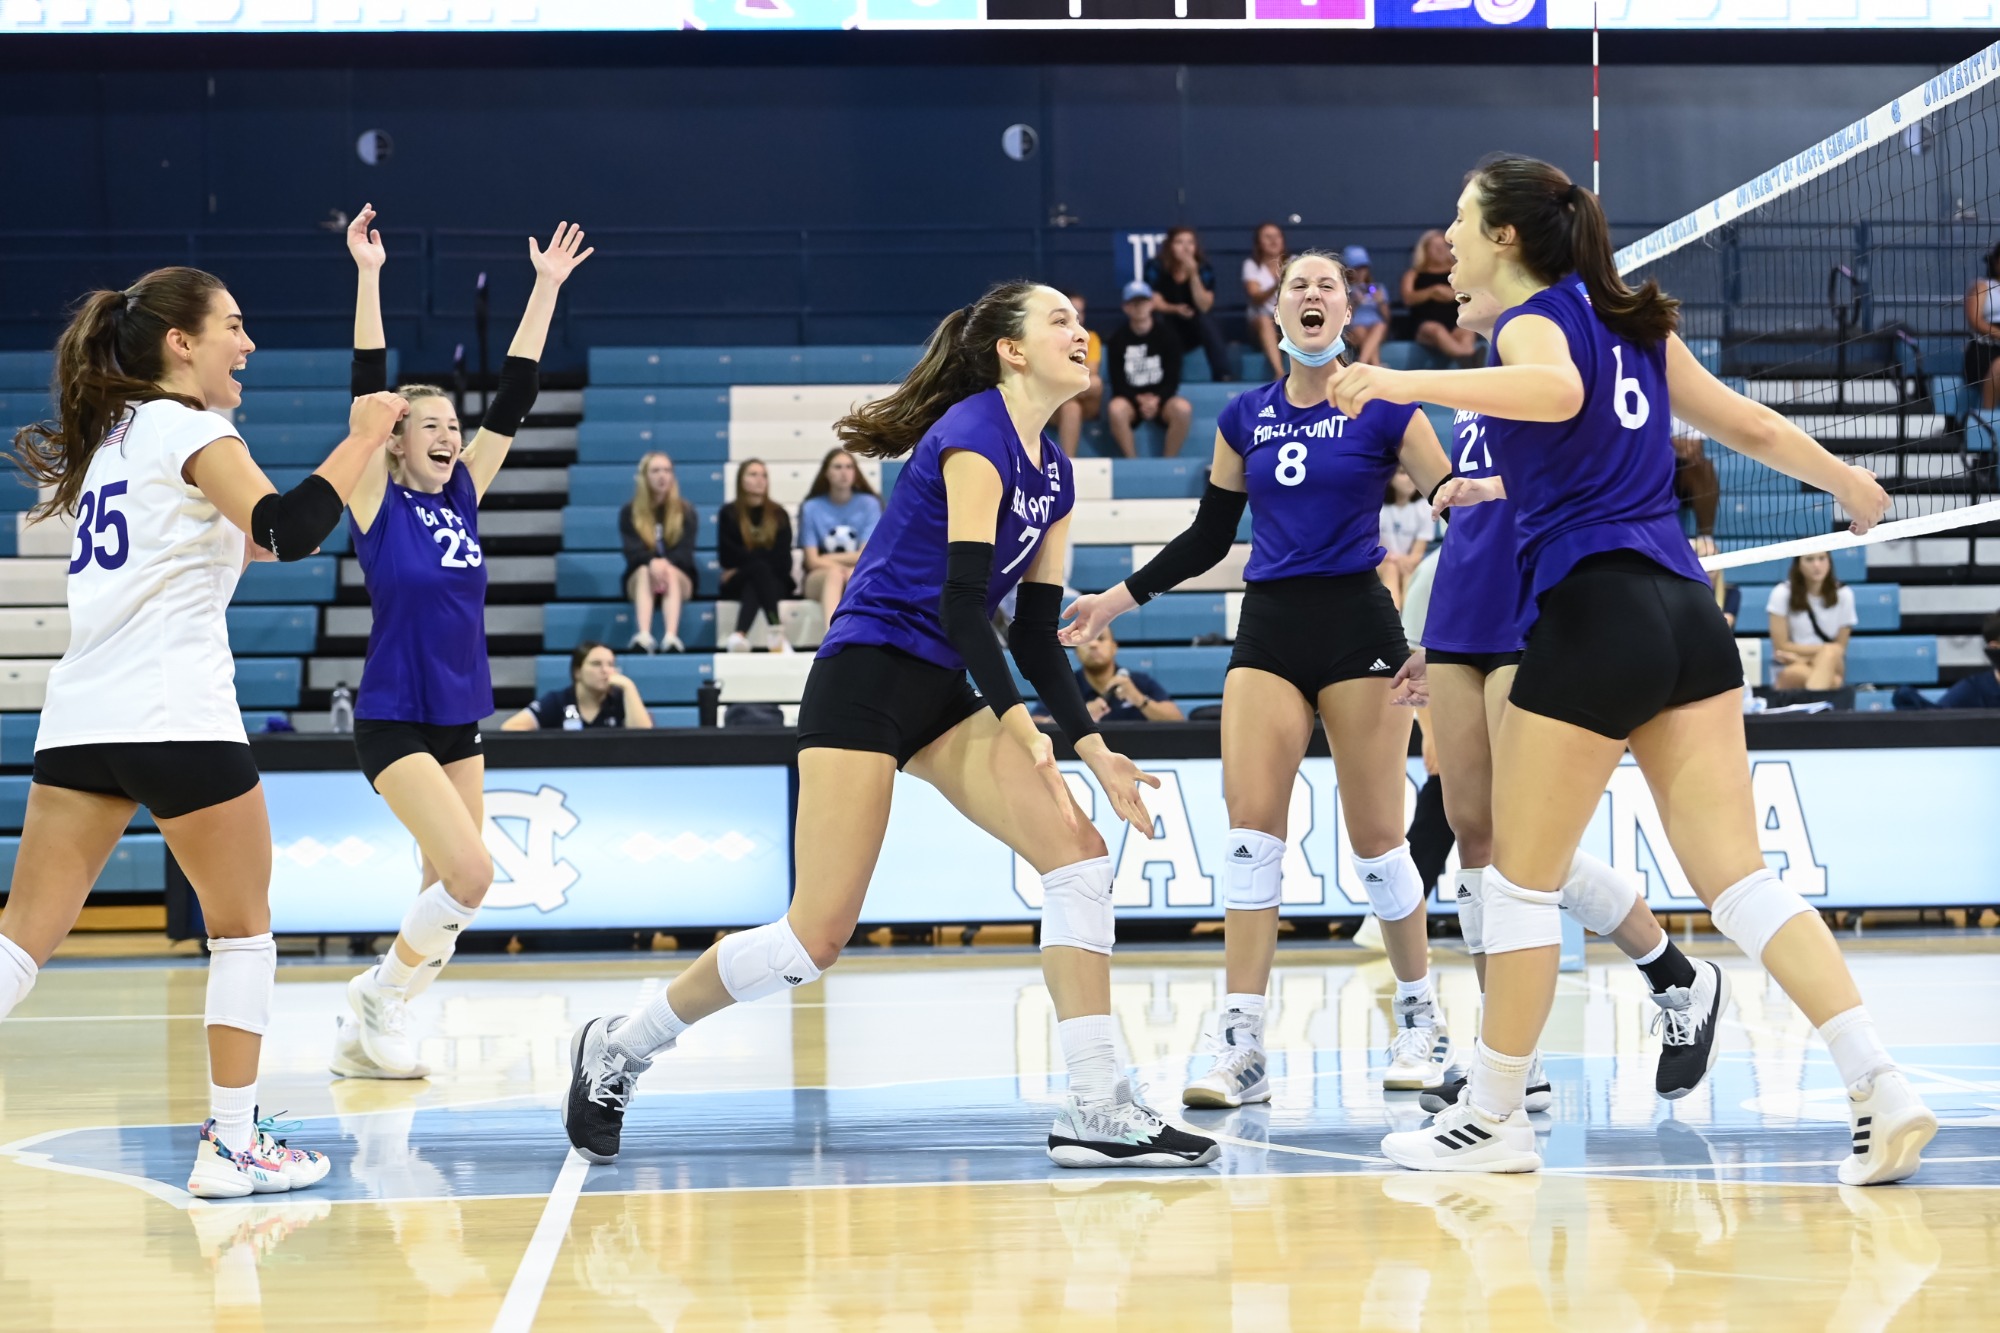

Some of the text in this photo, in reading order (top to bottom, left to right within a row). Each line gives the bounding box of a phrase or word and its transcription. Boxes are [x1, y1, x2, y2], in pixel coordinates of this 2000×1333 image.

[1612, 345, 1650, 430] 6
[1275, 441, 1308, 487] 8
[68, 479, 129, 573] 35
[1001, 525, 1041, 574] 7
